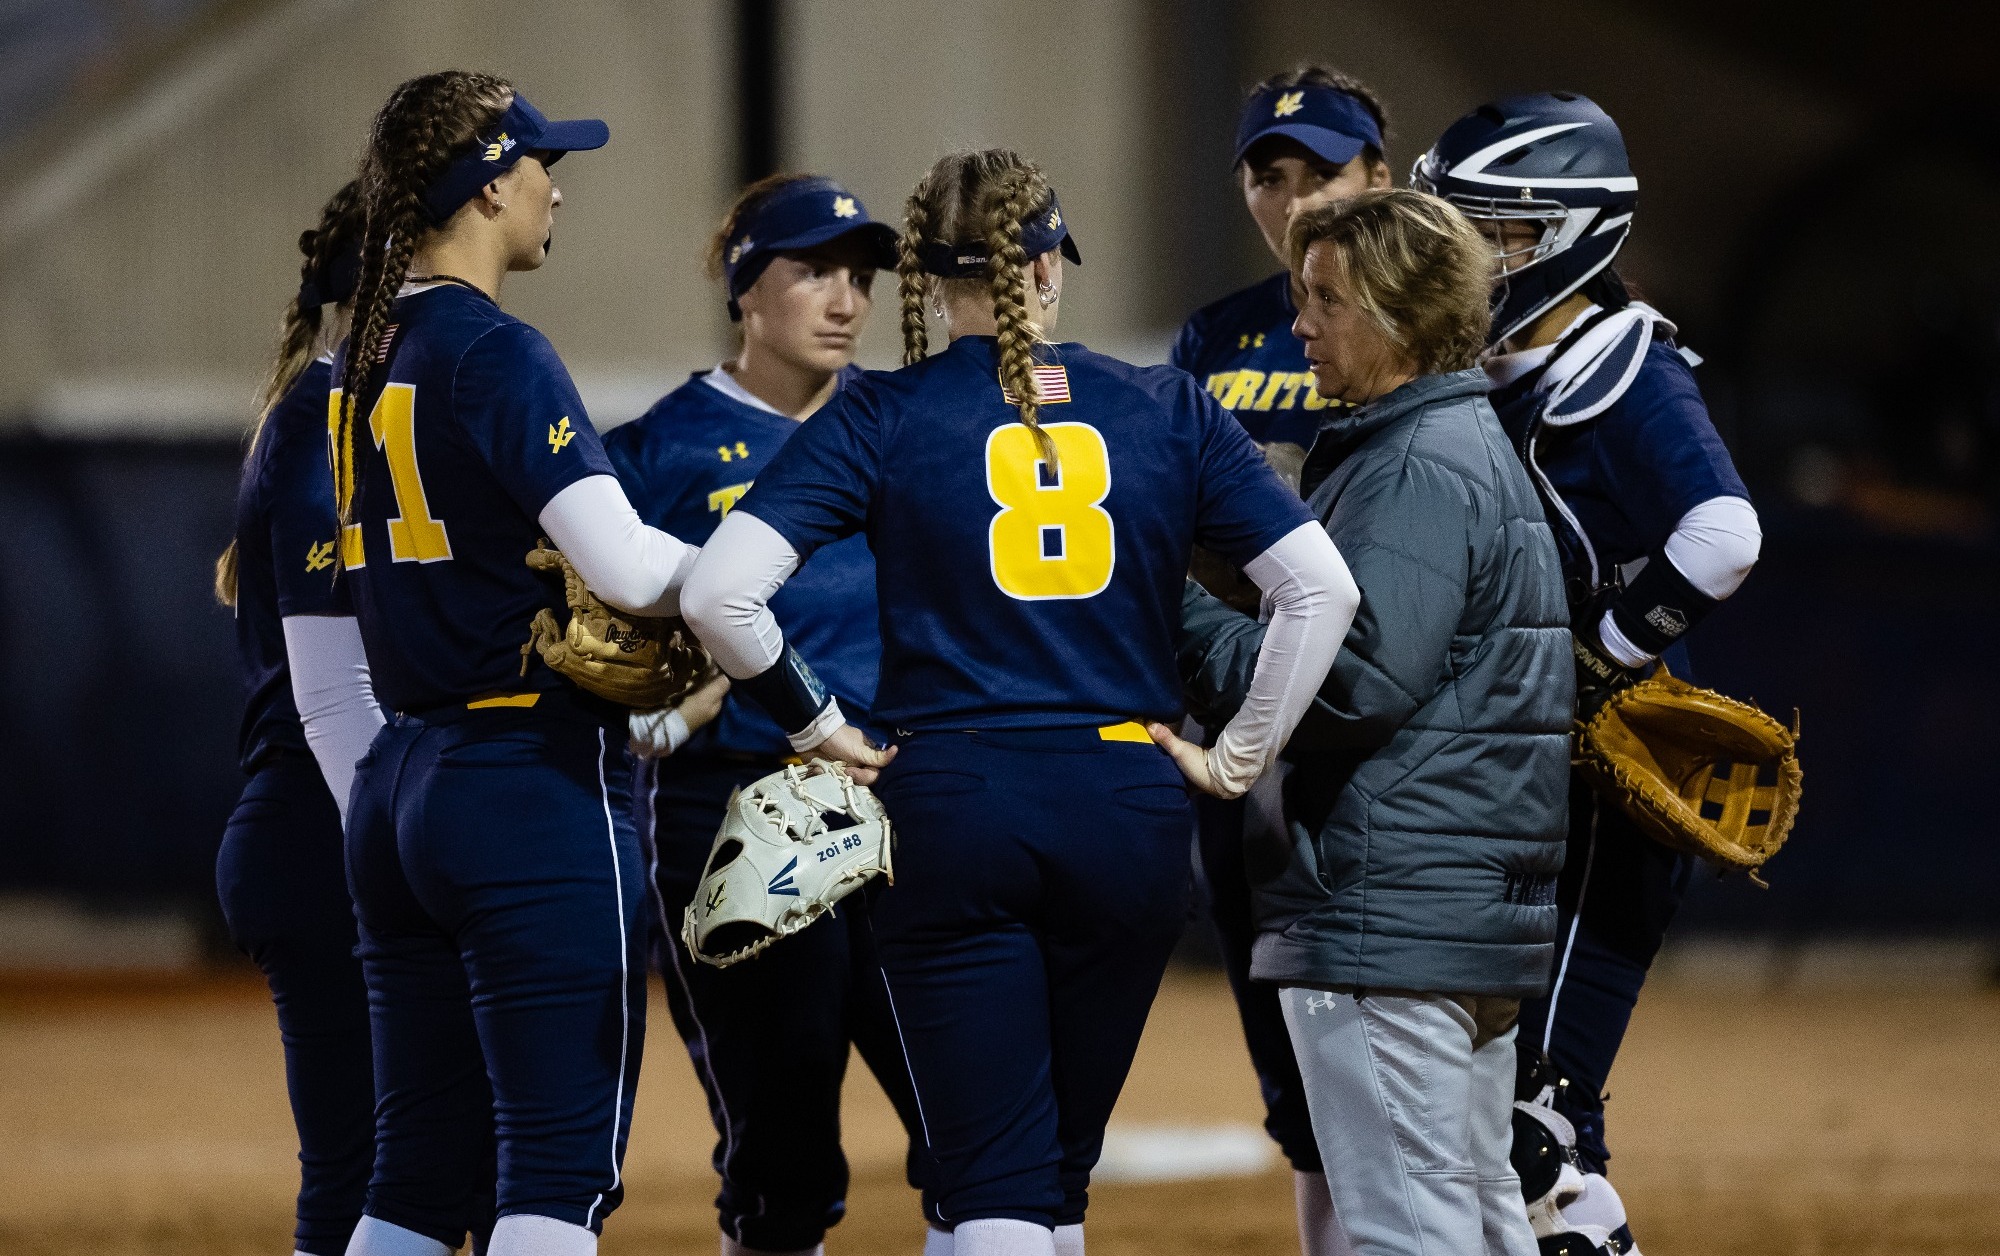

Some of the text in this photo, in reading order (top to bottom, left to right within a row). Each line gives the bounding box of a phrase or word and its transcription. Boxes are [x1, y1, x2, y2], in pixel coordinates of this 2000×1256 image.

[984, 421, 1116, 601] 8
[816, 833, 862, 863] zoi #8
